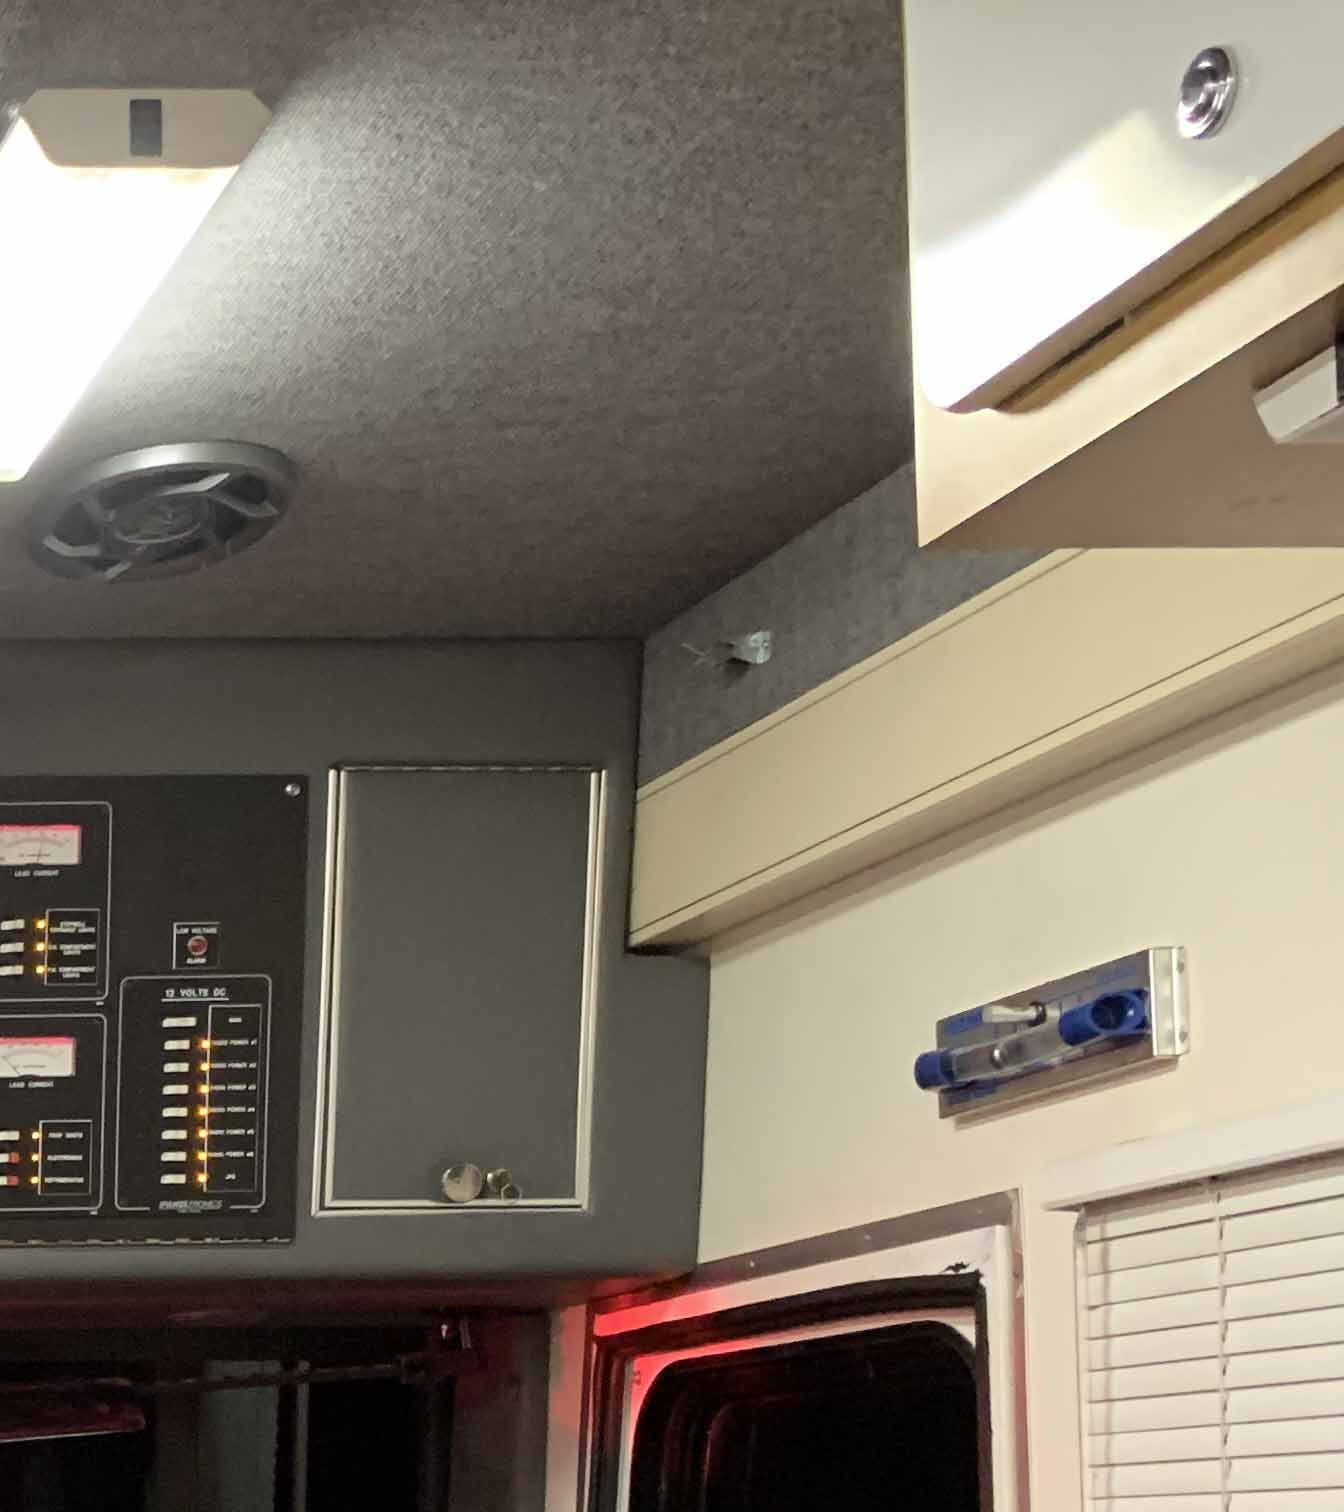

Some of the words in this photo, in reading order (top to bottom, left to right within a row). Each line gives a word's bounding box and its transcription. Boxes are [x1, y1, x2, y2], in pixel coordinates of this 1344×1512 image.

[165, 989, 175, 998] 12
[179, 988, 209, 998] VOLTS
[213, 987, 226, 997] DC
